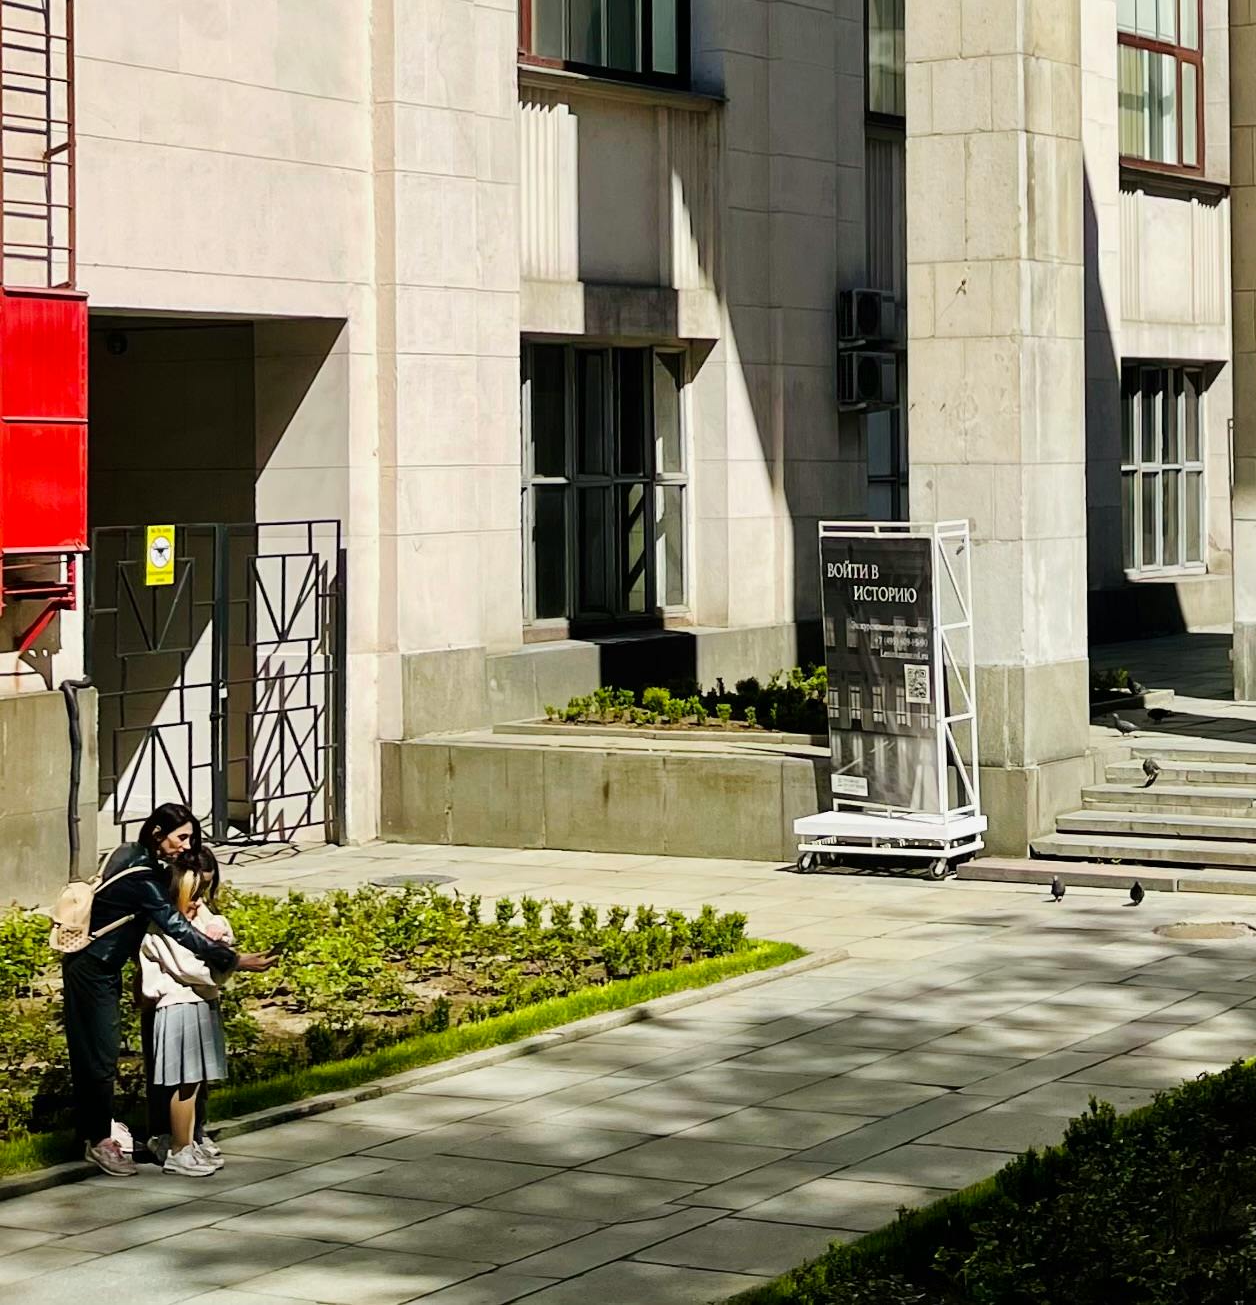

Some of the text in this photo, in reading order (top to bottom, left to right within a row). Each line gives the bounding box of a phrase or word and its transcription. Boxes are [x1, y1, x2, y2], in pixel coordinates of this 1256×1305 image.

[827, 560, 880, 580] ВОЙТИ В
[853, 585, 918, 604] ИСТОРИЮ
